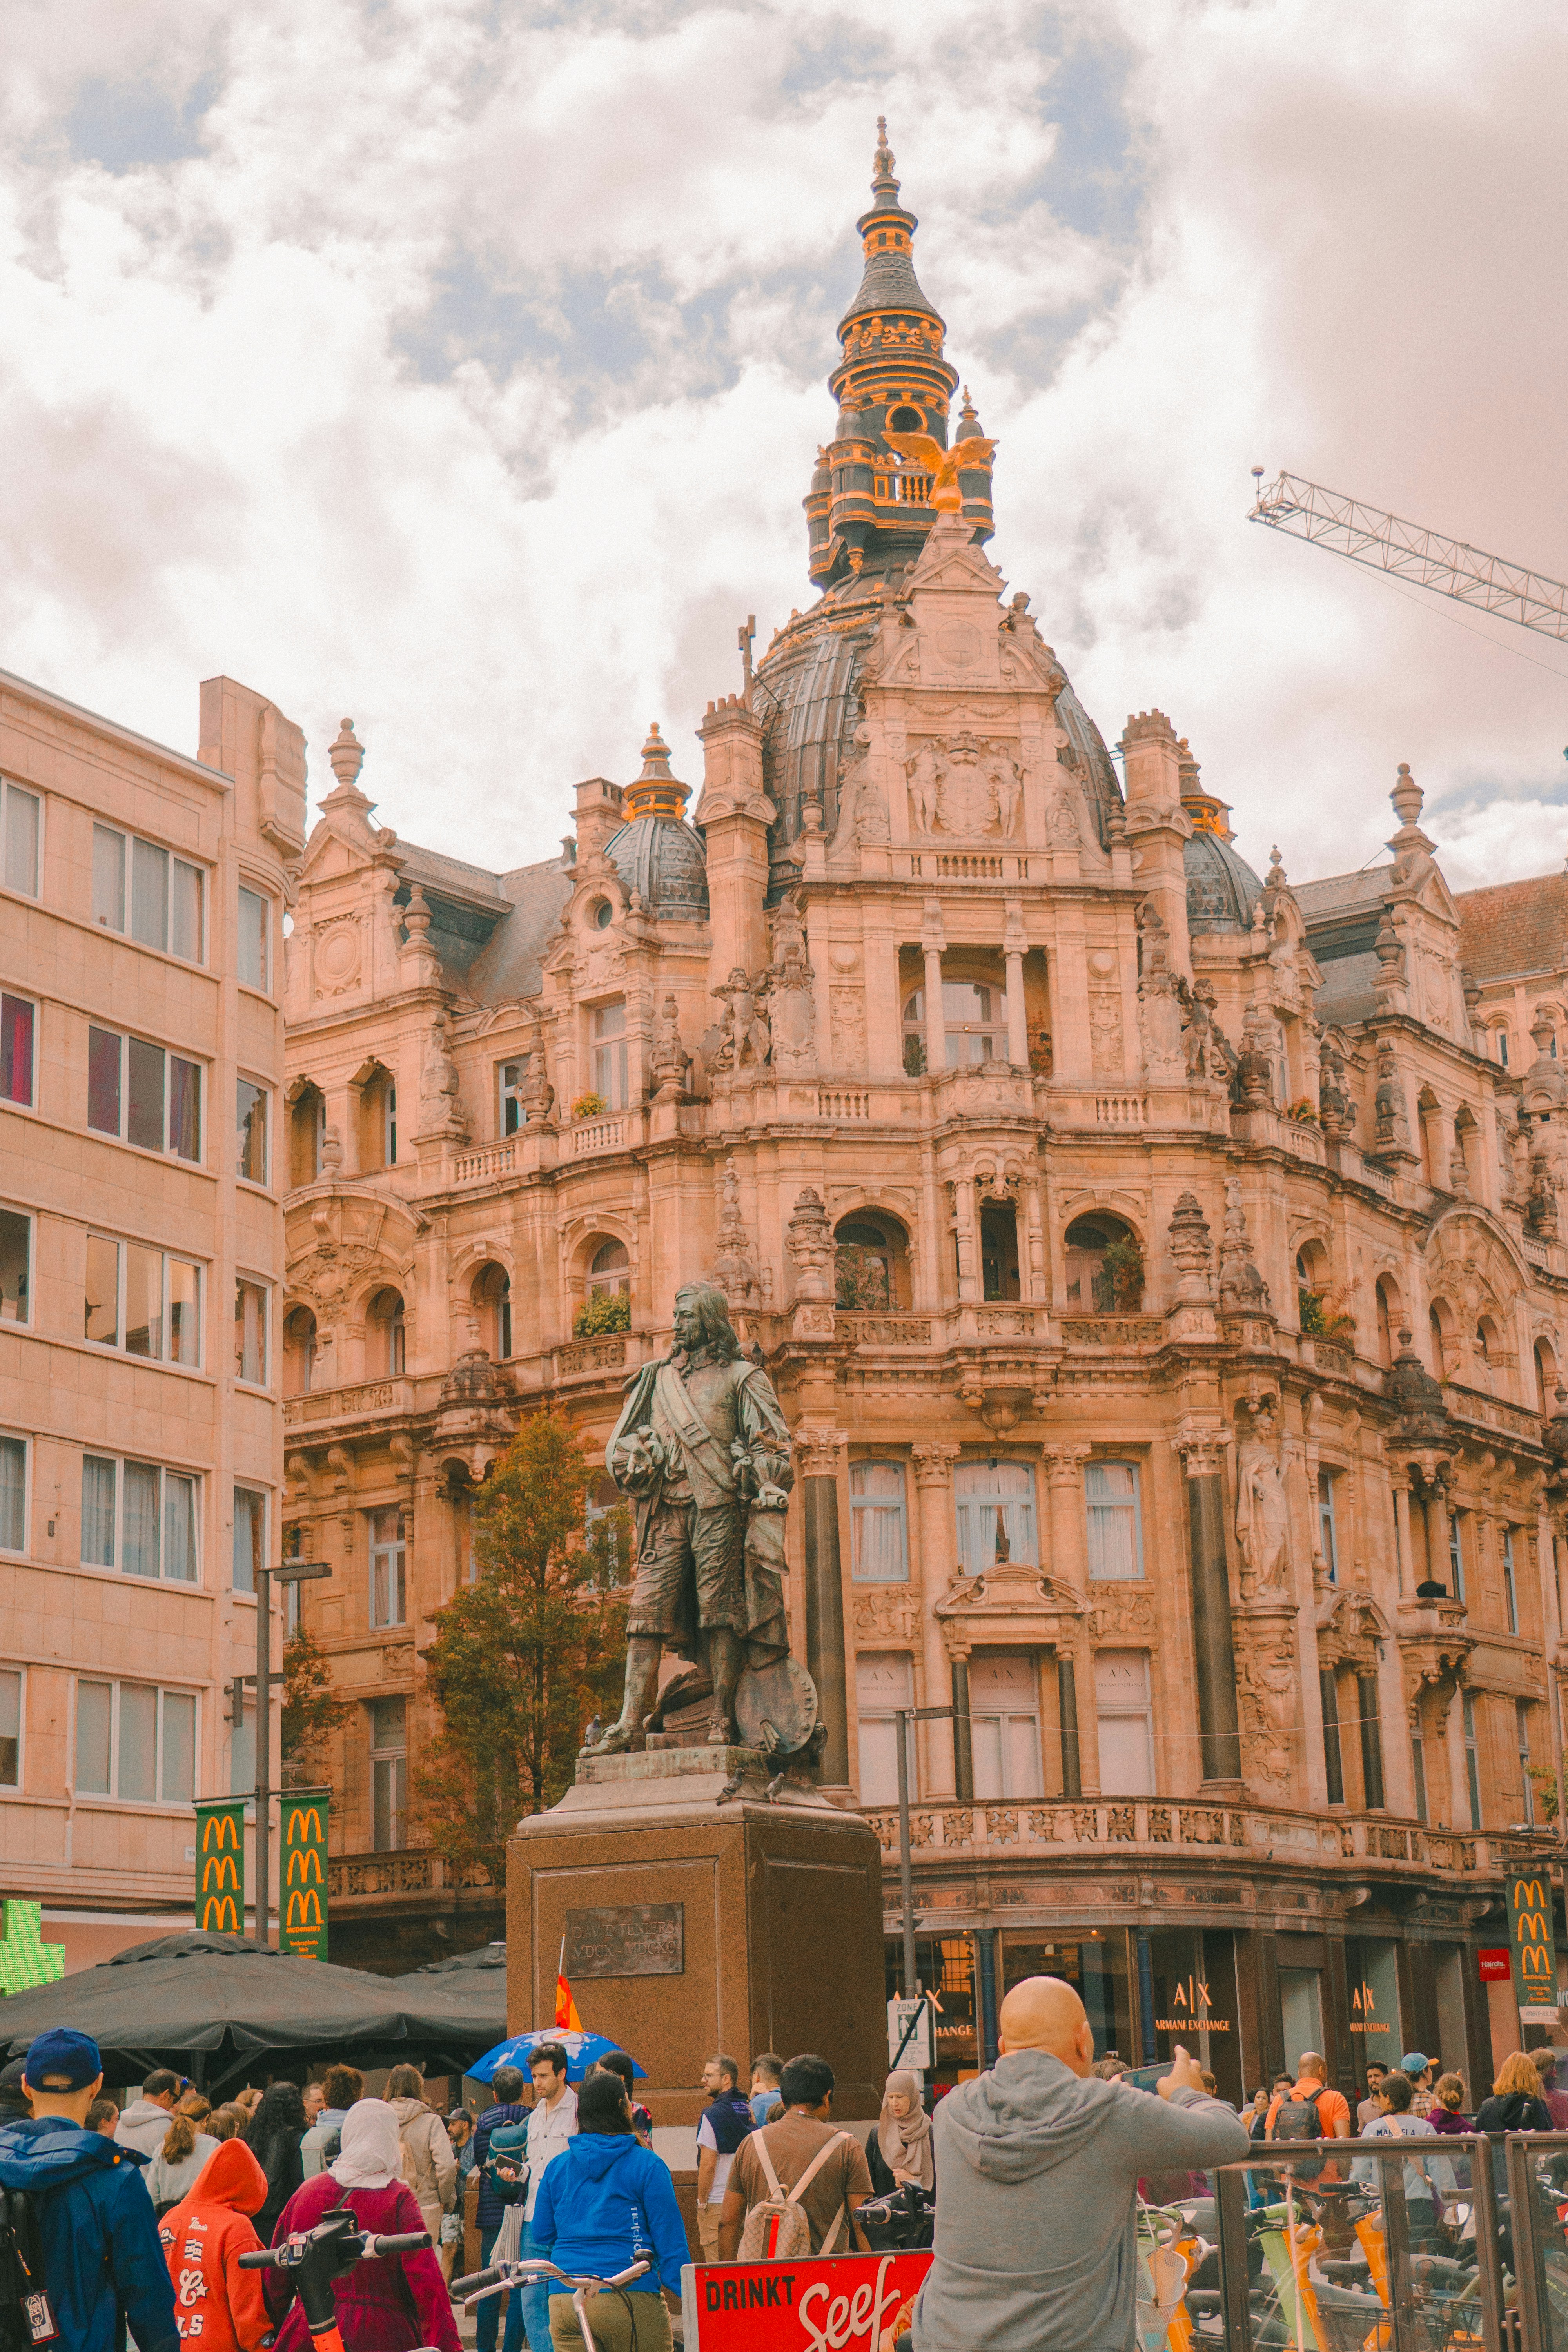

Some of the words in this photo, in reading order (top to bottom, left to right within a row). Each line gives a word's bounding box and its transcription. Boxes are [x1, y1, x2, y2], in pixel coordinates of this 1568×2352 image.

[618, 1921, 675, 1936] TENIERS
[572, 1944, 614, 1958] MDCX
[897, 2003, 917, 2012] ZONE
[1156, 2020, 1186, 2030] ARMANI
[1188, 2020, 1230, 2031] EXCHANGE
[706, 2275, 795, 2312] DRINKT
[799, 2255, 901, 2352] Seef
